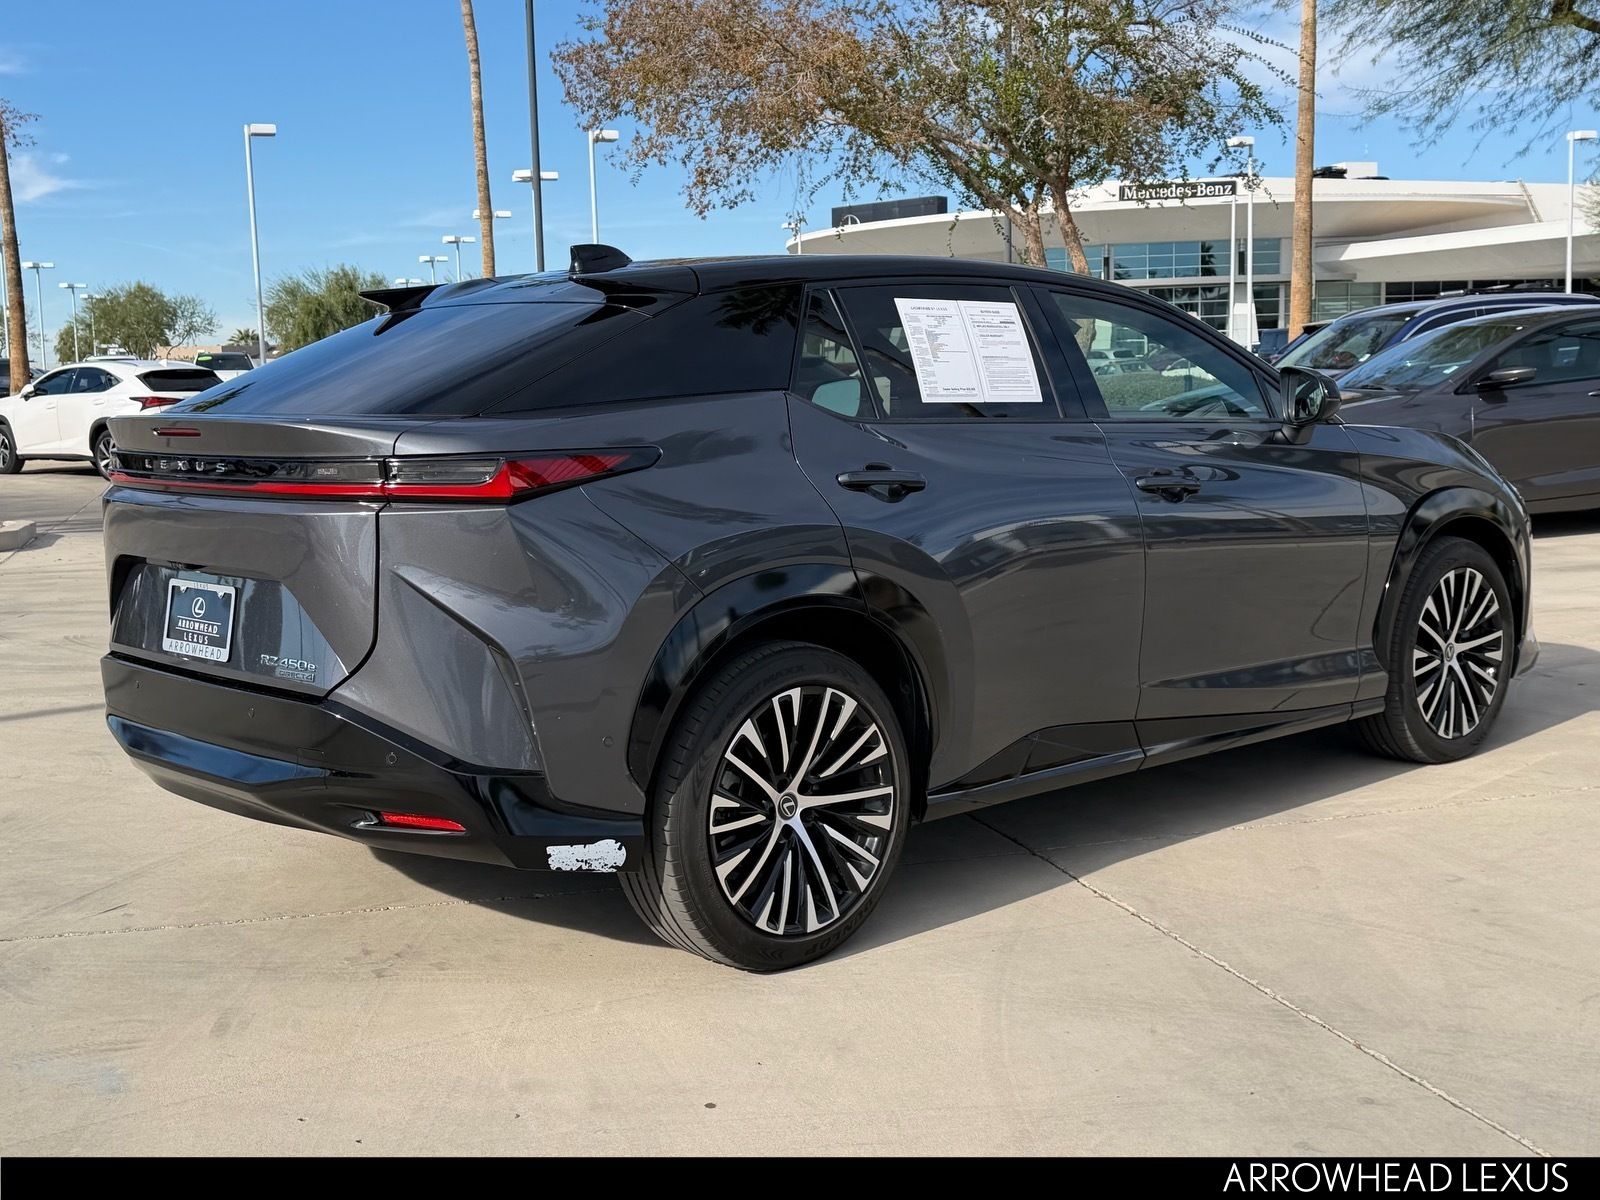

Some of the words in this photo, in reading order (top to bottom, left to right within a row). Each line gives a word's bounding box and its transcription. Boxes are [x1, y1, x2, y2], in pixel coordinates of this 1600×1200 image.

[1123, 183, 1233, 200] Mercedes-Benz
[144, 458, 227, 473] LEXUS
[193, 582, 209, 590] LEXUS
[177, 618, 218, 634] ARROWHEAD
[183, 632, 209, 645] LEXUS
[168, 640, 222, 660] ARROWHEAD
